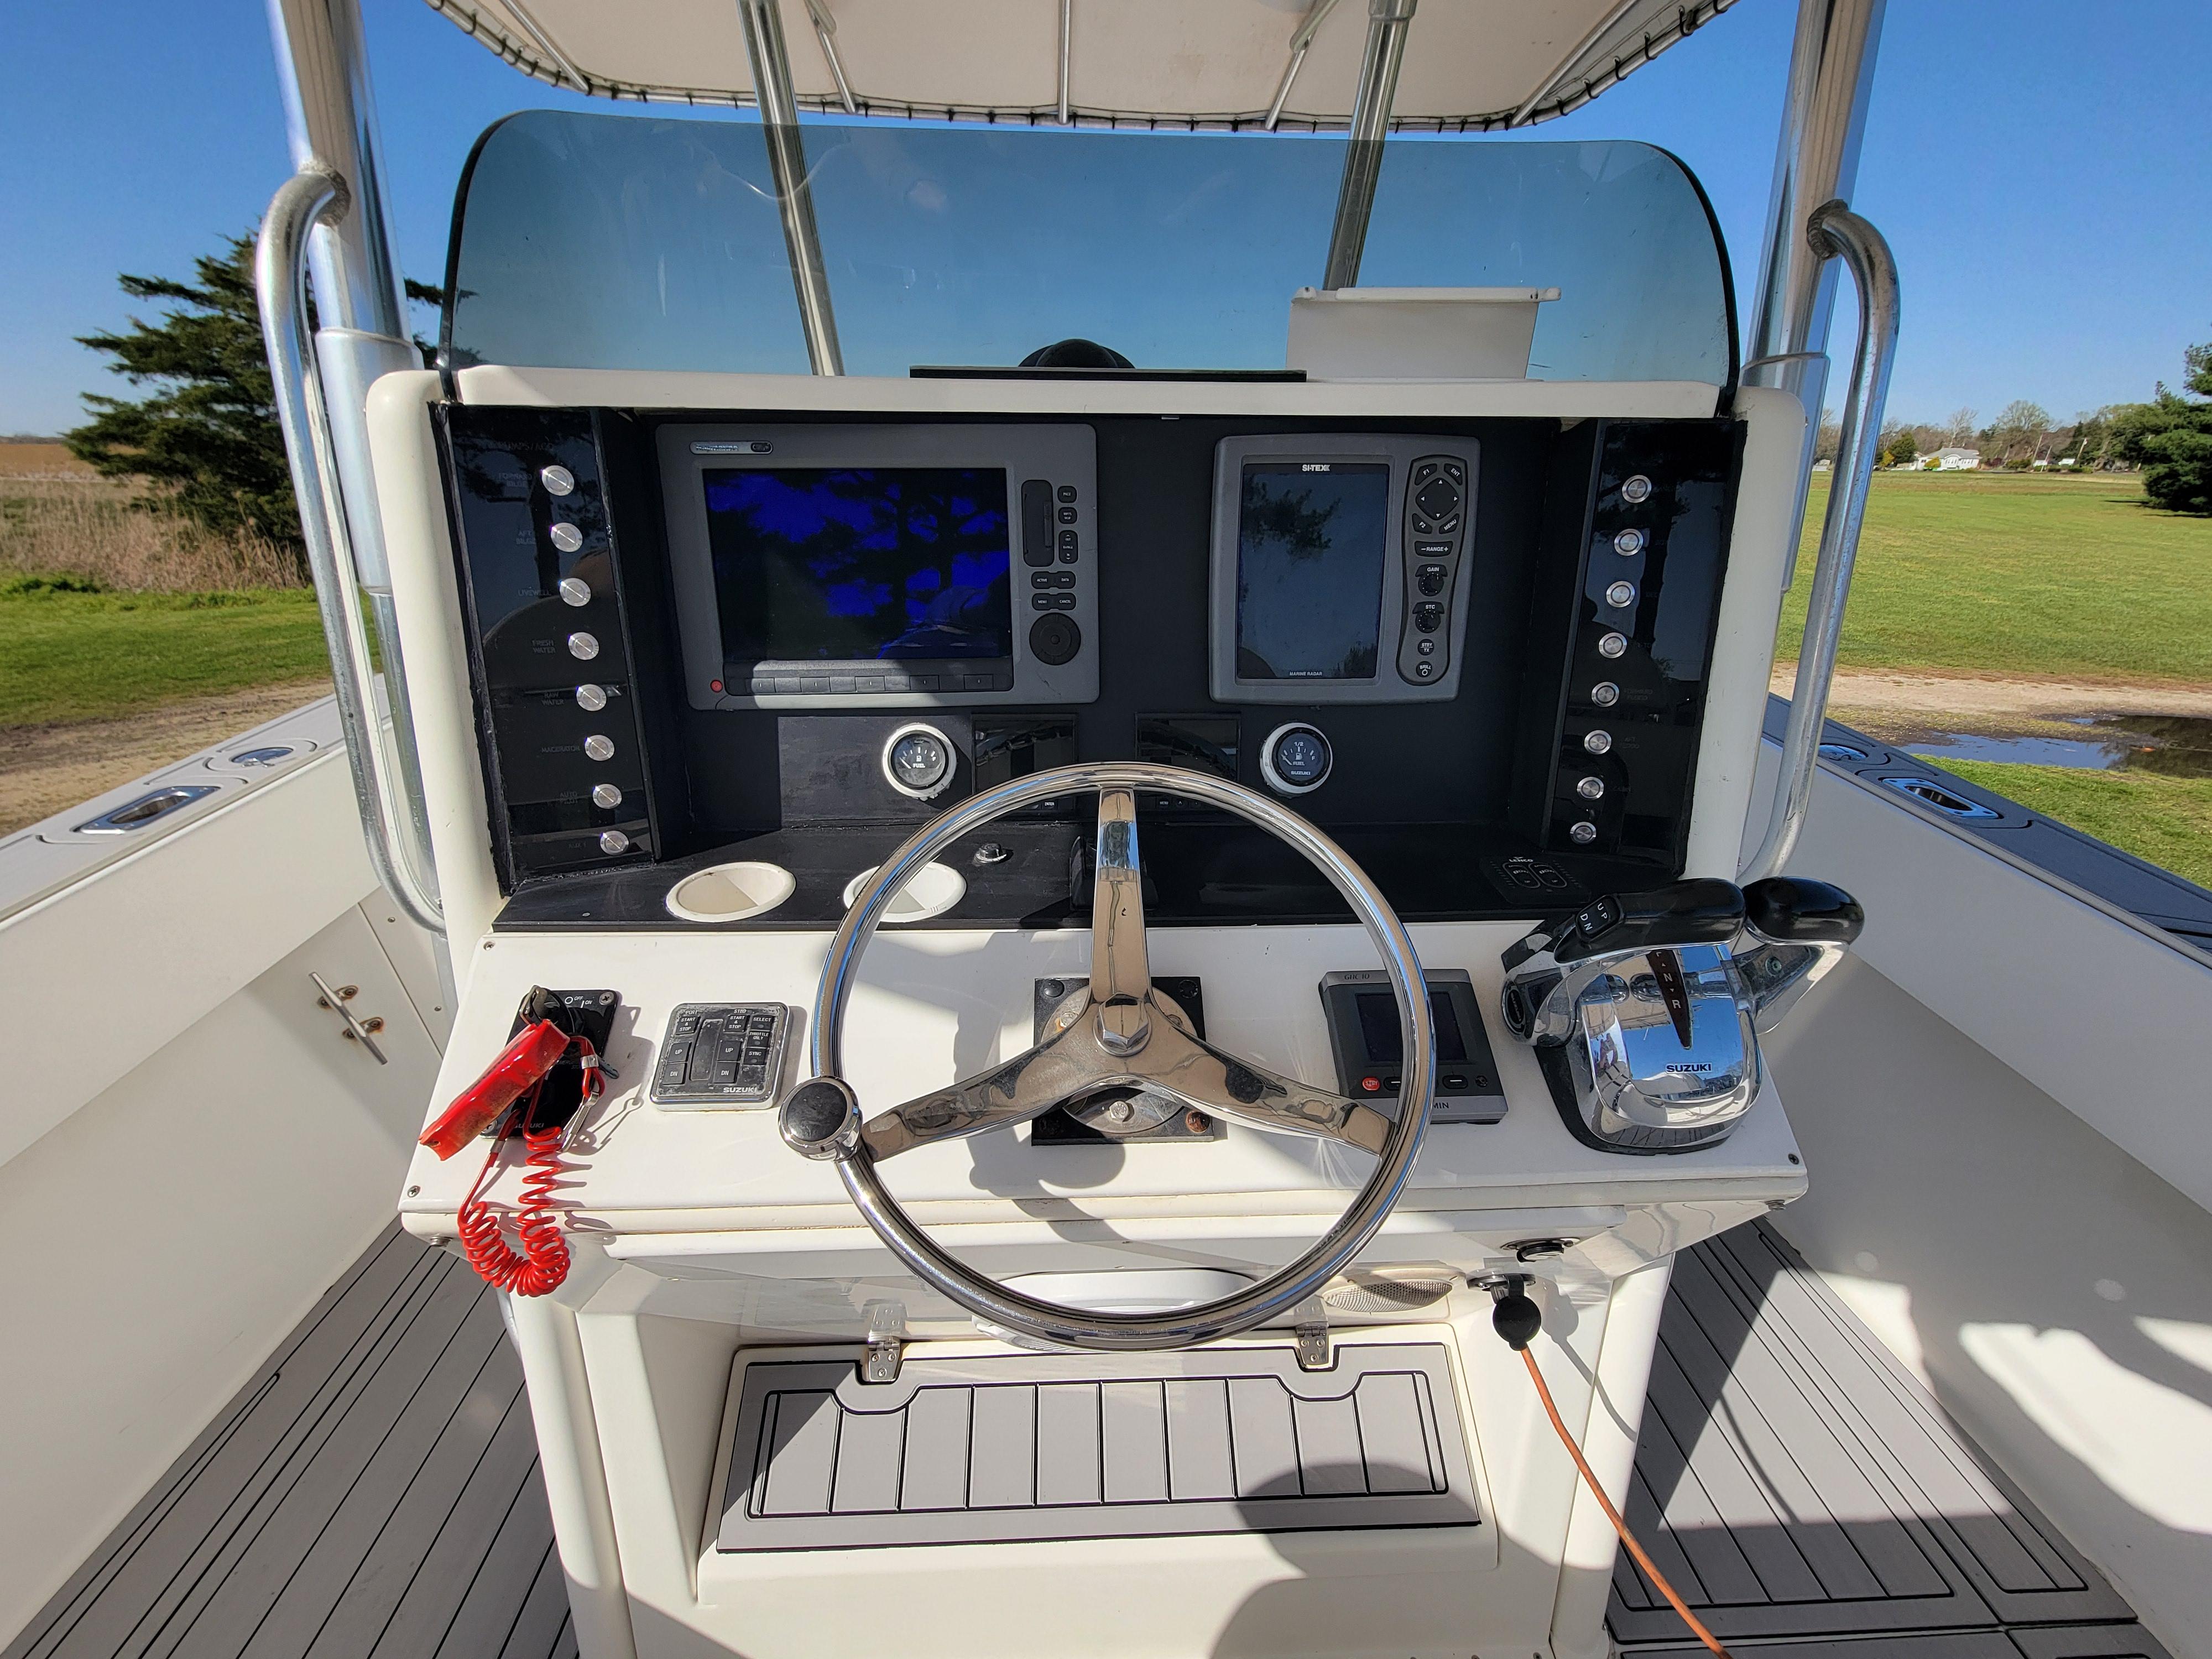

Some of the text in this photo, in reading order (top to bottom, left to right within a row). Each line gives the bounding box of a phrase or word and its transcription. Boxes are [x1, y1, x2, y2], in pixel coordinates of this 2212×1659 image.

[1451, 468, 1460, 478] ENT
[1444, 519, 1457, 531] MENU
[1597, 902, 1608, 919] UP
[1580, 913, 1593, 931] DN
[1663, 973, 1673, 982] N
[1672, 999, 1681, 1009] R
[1666, 1063, 1712, 1072] SUZUKI
